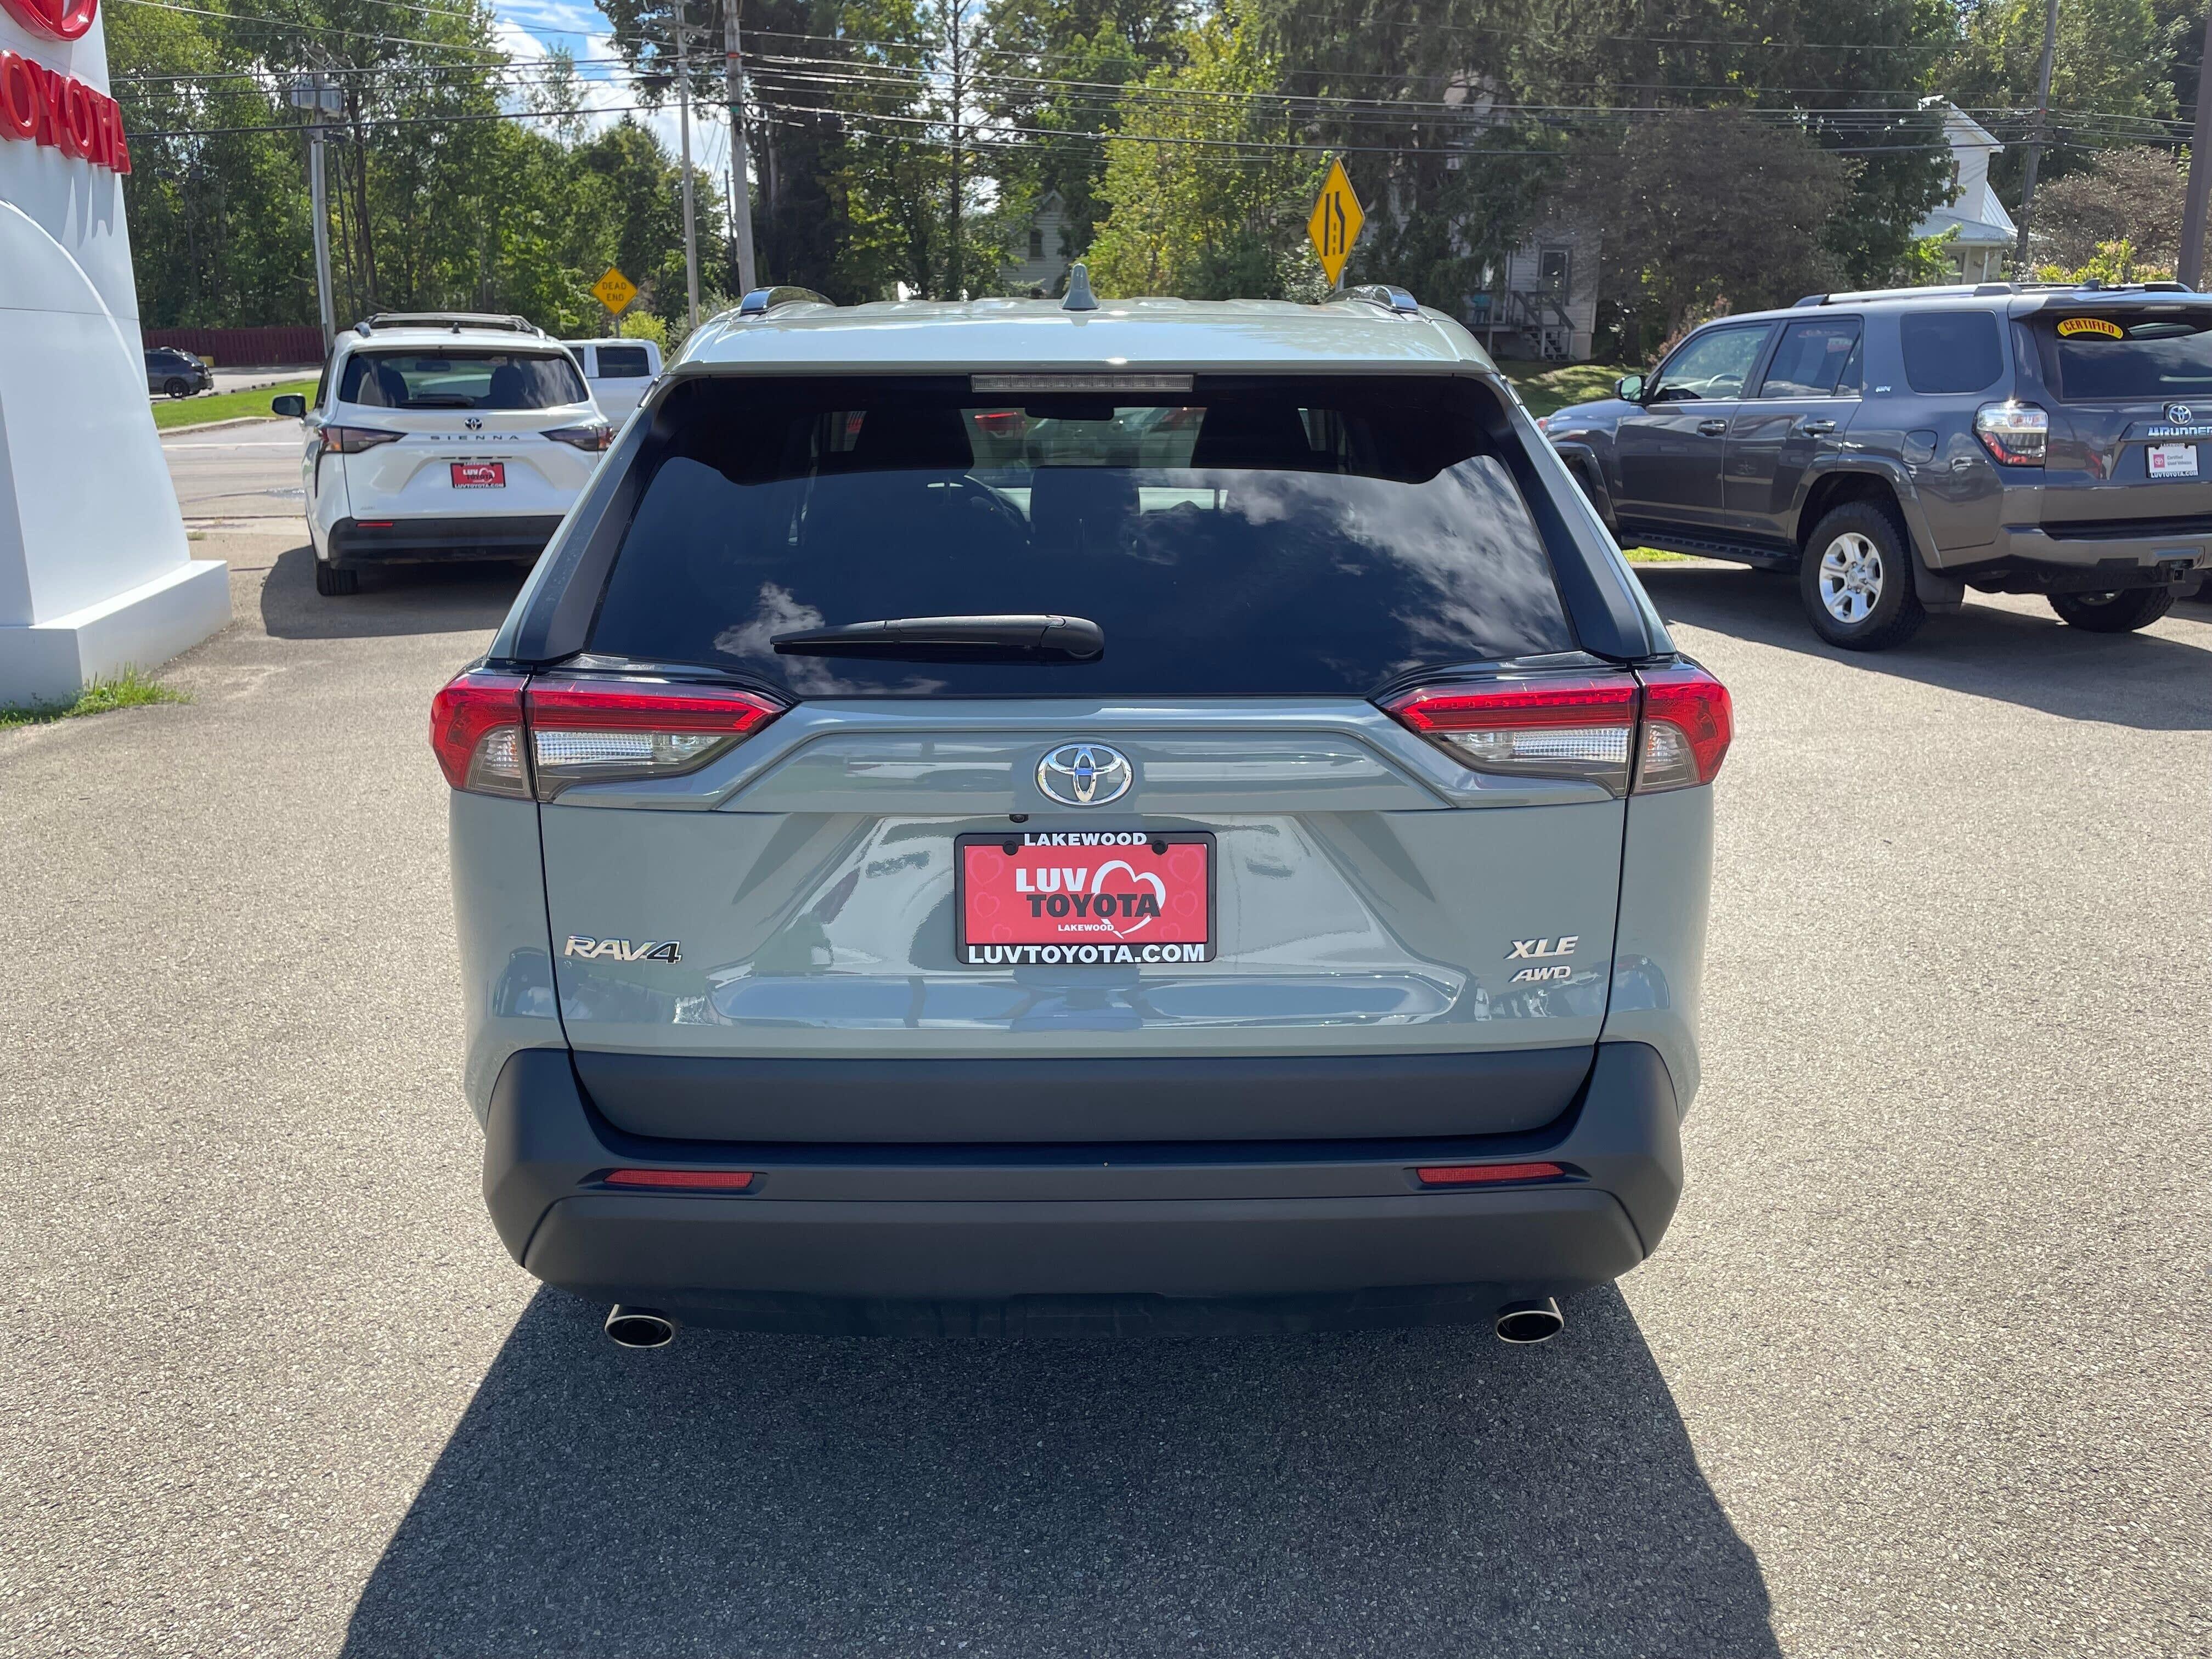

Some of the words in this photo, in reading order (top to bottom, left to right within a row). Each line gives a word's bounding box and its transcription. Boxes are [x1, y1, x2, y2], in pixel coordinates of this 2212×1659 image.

[0, 49, 132, 175] OYOTA
[602, 281, 627, 290] DEAD
[606, 293, 624, 301] END
[2063, 319, 2114, 334] CERTIFIED
[1024, 833, 1147, 846] LAKEWOOD
[1016, 868, 1087, 891] LUV
[1026, 894, 1161, 917] TOYOTA
[565, 935, 682, 964] RAV4
[968, 944, 1205, 963] LUVTOYOTA.COM
[1504, 935, 1579, 960] XLE
[1509, 966, 1571, 983] AWD
